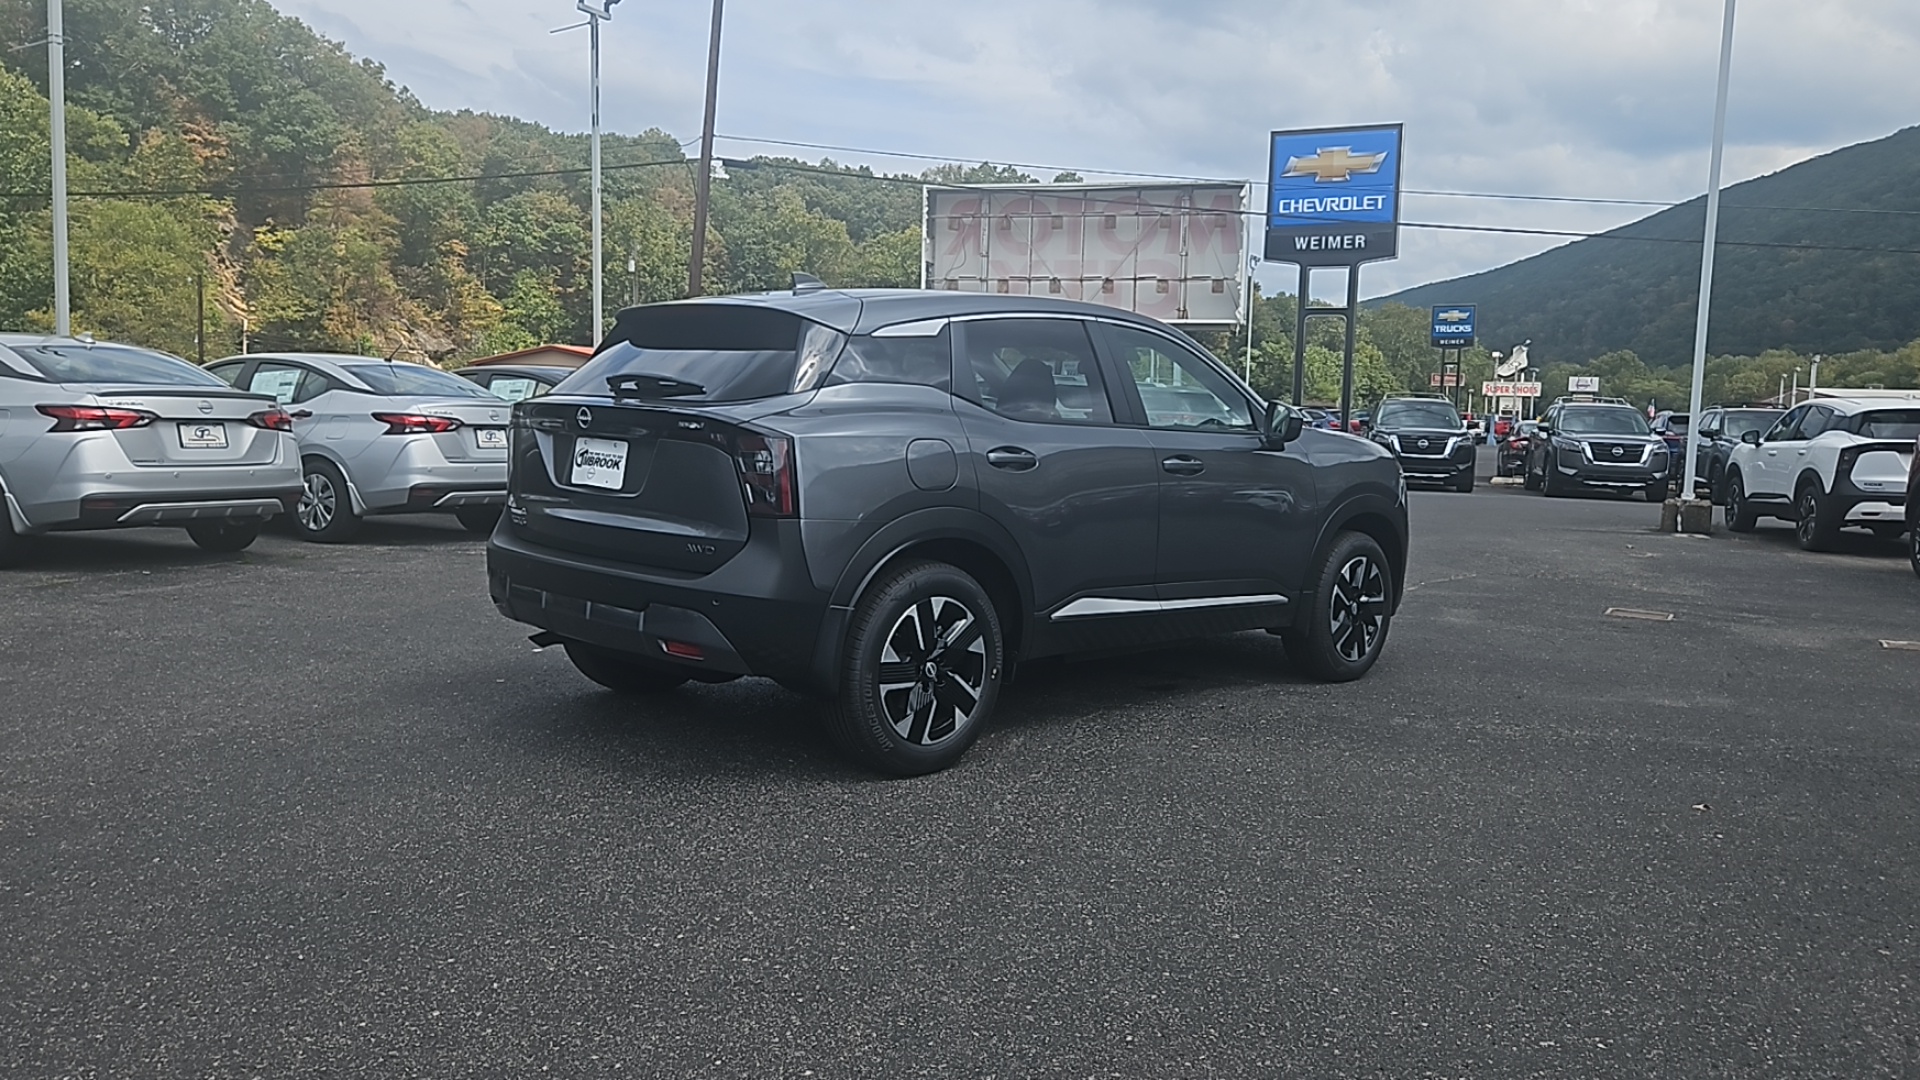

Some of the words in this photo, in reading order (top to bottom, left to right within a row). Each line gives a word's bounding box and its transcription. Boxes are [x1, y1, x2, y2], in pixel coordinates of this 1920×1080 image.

[1279, 195, 1387, 214] CHEVROLET
[1294, 234, 1367, 251] WEIMER
[1434, 324, 1472, 333] TRUCKS
[1485, 383, 1510, 394] SUPER
[1511, 382, 1538, 395] SHOES
